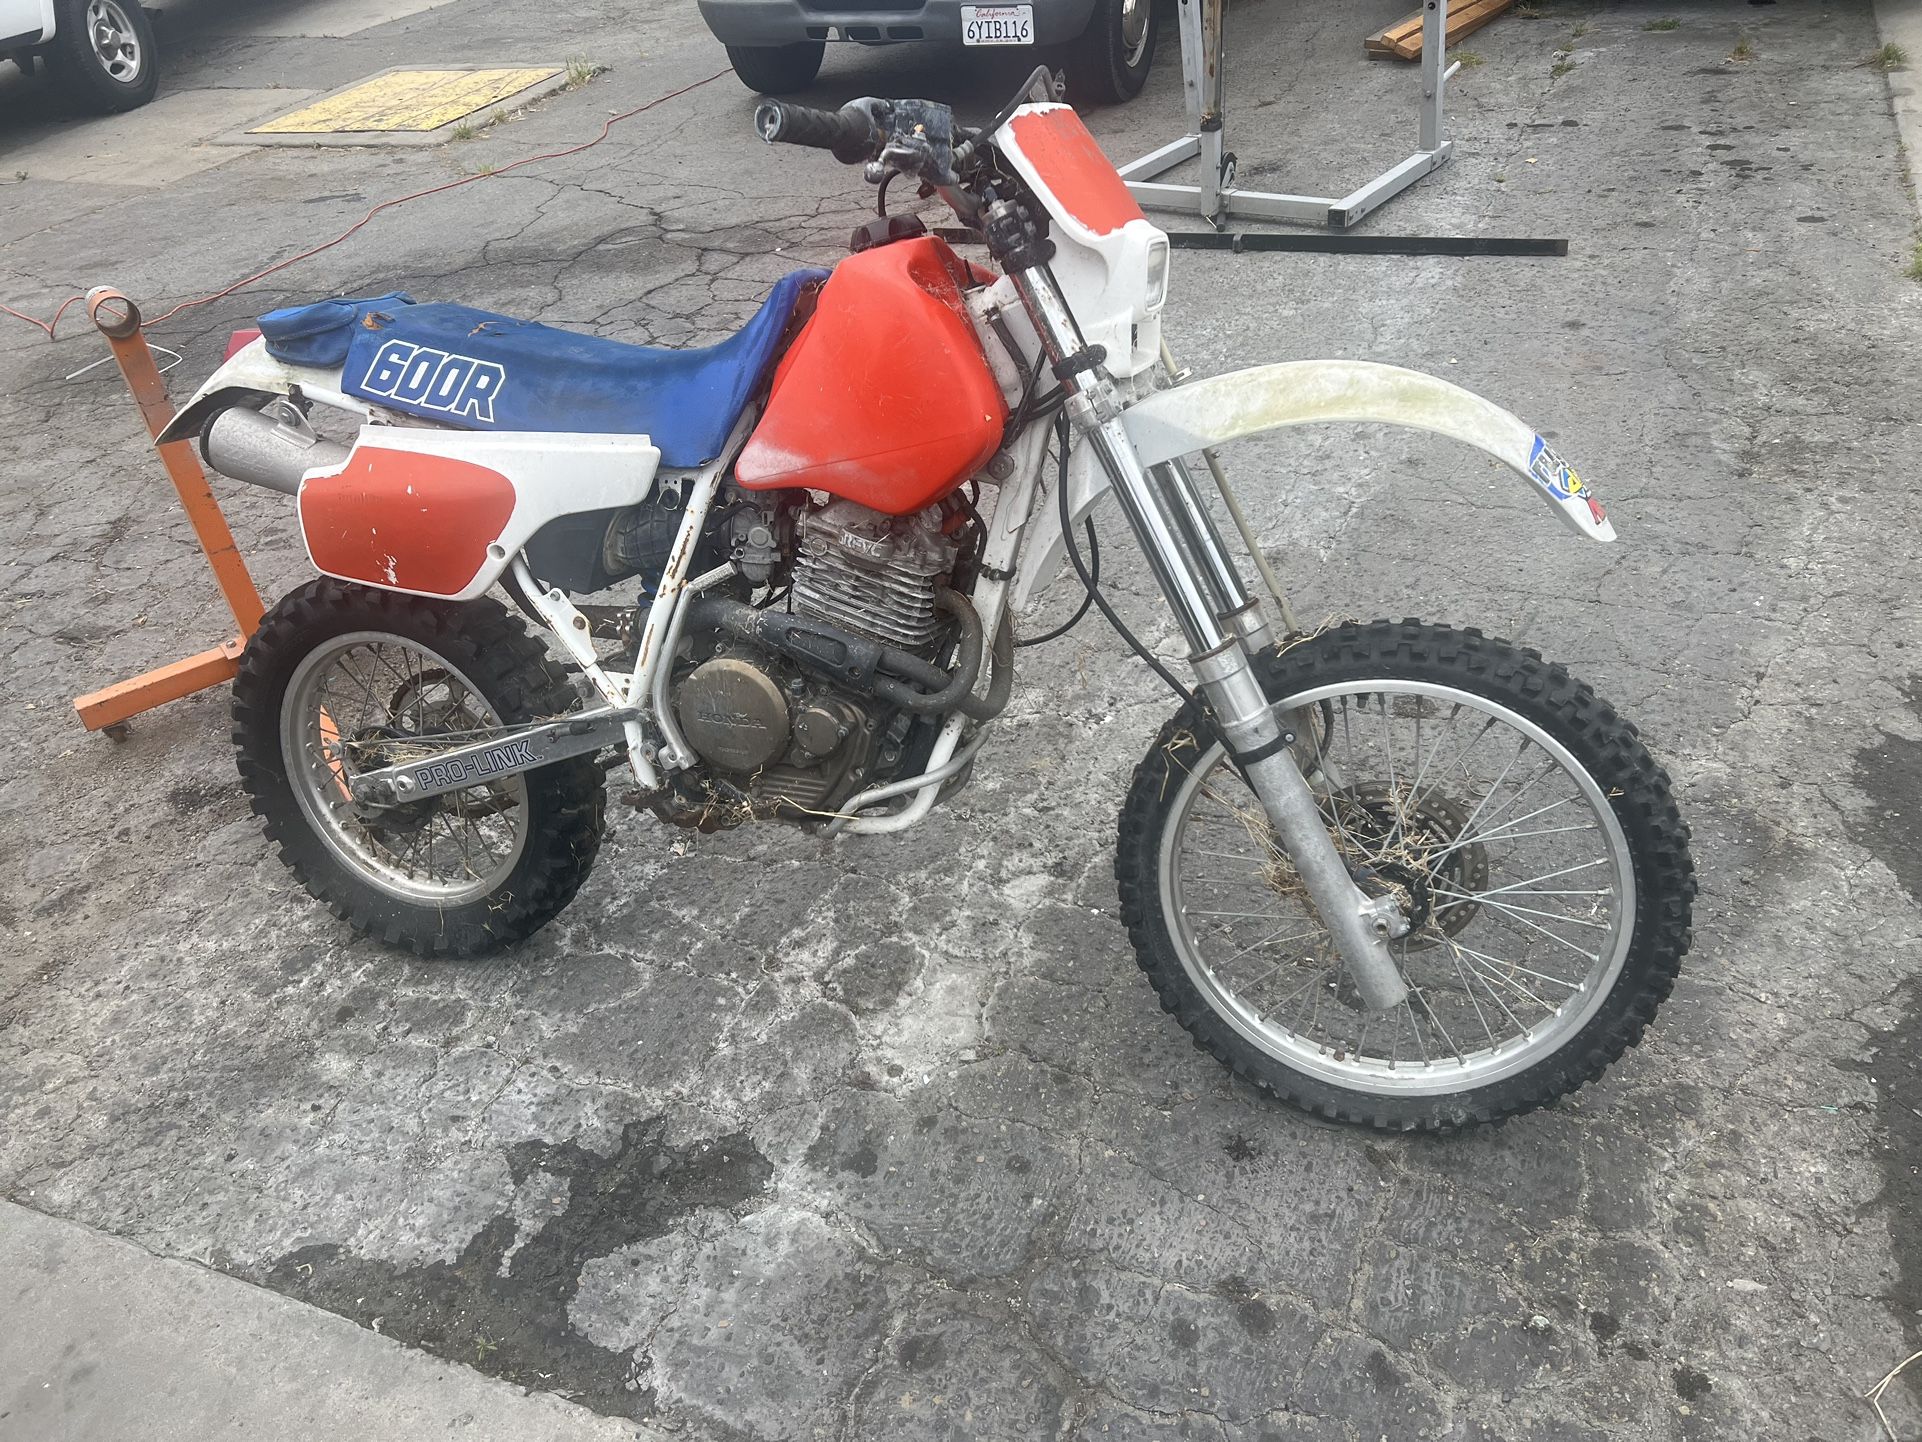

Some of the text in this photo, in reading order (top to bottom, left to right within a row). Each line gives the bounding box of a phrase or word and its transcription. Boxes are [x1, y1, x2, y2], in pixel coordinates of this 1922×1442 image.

[976, 8, 1020, 19] California
[967, 20, 1029, 39] 6YIB116
[360, 338, 506, 423] 600R
[697, 711, 768, 730] HONDA
[414, 740, 537, 790] PRO-LINK
